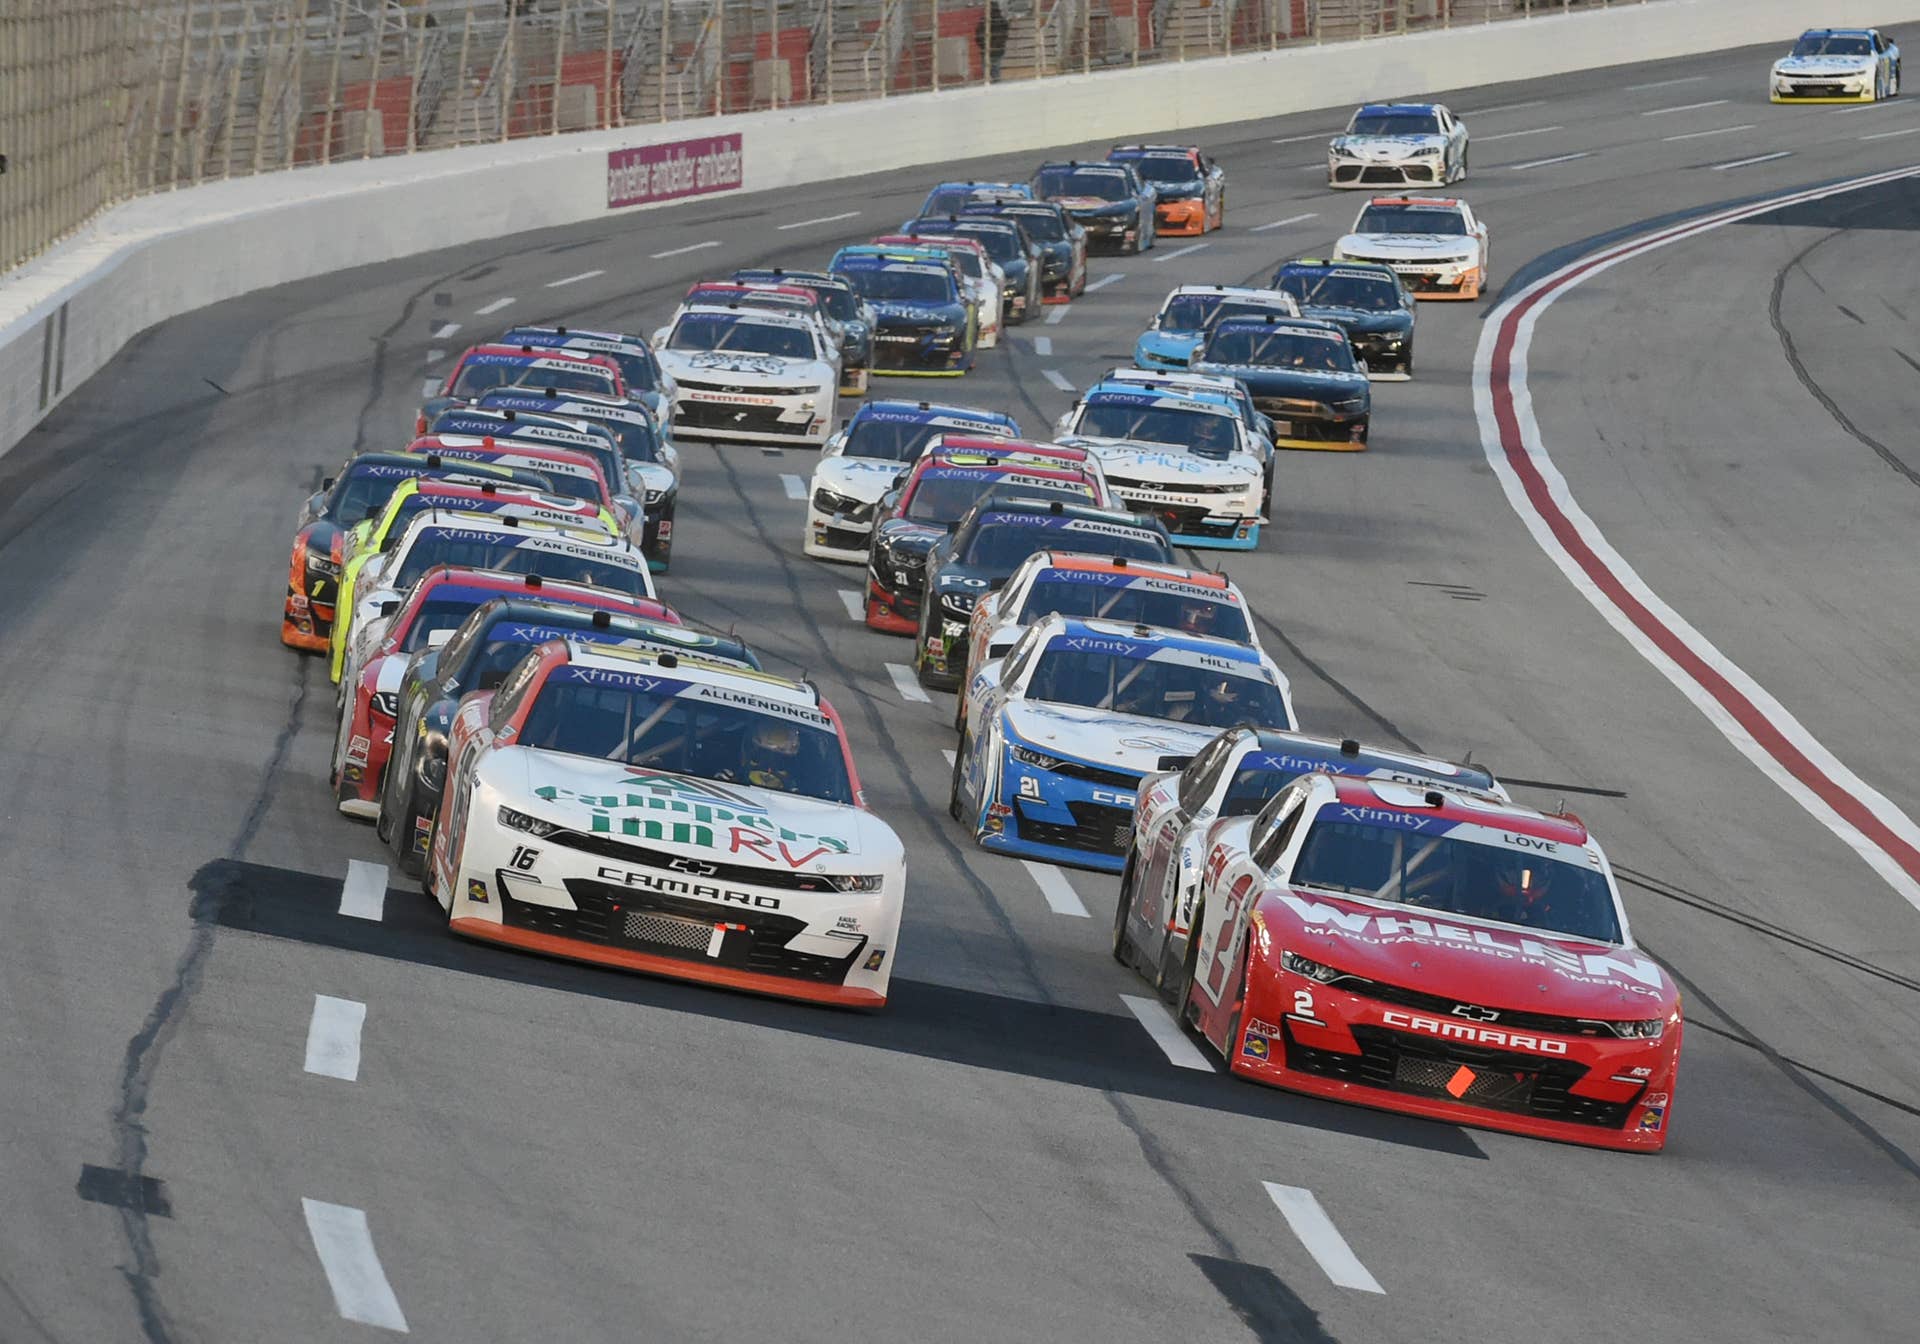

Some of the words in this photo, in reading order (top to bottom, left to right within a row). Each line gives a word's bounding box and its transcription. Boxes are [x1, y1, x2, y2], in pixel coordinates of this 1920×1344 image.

[545, 360, 610, 375] ALFREDO
[496, 398, 547, 410] xfinity
[691, 393, 774, 405] CAMARO
[1100, 393, 1145, 404] xfinity
[1178, 401, 1213, 410] POOLE
[581, 405, 625, 418] SMITH
[871, 412, 920, 423] xfinity
[450, 420, 504, 433] xfinity
[952, 419, 1002, 432] DEEGAN
[530, 428, 598, 444] ALLGAIER
[426, 448, 484, 461] xfinity
[528, 459, 576, 473] SMITH
[936, 469, 990, 481] xfinity
[1010, 475, 1088, 494] RETZLAF
[419, 495, 484, 510] xfinity
[531, 509, 585, 525] JONES
[995, 513, 1053, 527] xfinity
[436, 527, 506, 544] xfinity
[1073, 522, 1155, 540] EARNHARD
[533, 539, 562, 551] VAN
[894, 571, 909, 586] 31
[1052, 571, 1117, 585] xfinity
[311, 580, 326, 597] 1
[1145, 580, 1230, 600] KLIGERMAN
[1066, 637, 1138, 655] xfinity
[1200, 656, 1236, 670] HILL
[571, 667, 662, 692] xfinity
[699, 687, 832, 727] ALLMENDINGER
[1263, 754, 1346, 775] xfinity
[1019, 776, 1040, 798] 21
[1340, 804, 1431, 831] xfinity
[728, 826, 832, 868] RV
[1504, 833, 1558, 854] LOVE
[509, 845, 540, 871] 16
[598, 866, 781, 910] CAMARO
[1278, 895, 1663, 989] WHELEN
[1304, 926, 1518, 960] MANUFACTURED
[1520, 952, 1546, 966] IN
[1552, 968, 1661, 998] AMERICA
[1293, 990, 1316, 1018] 2
[1249, 1019, 1279, 1037] ARP
[1383, 1010, 1567, 1055] CAMARO
